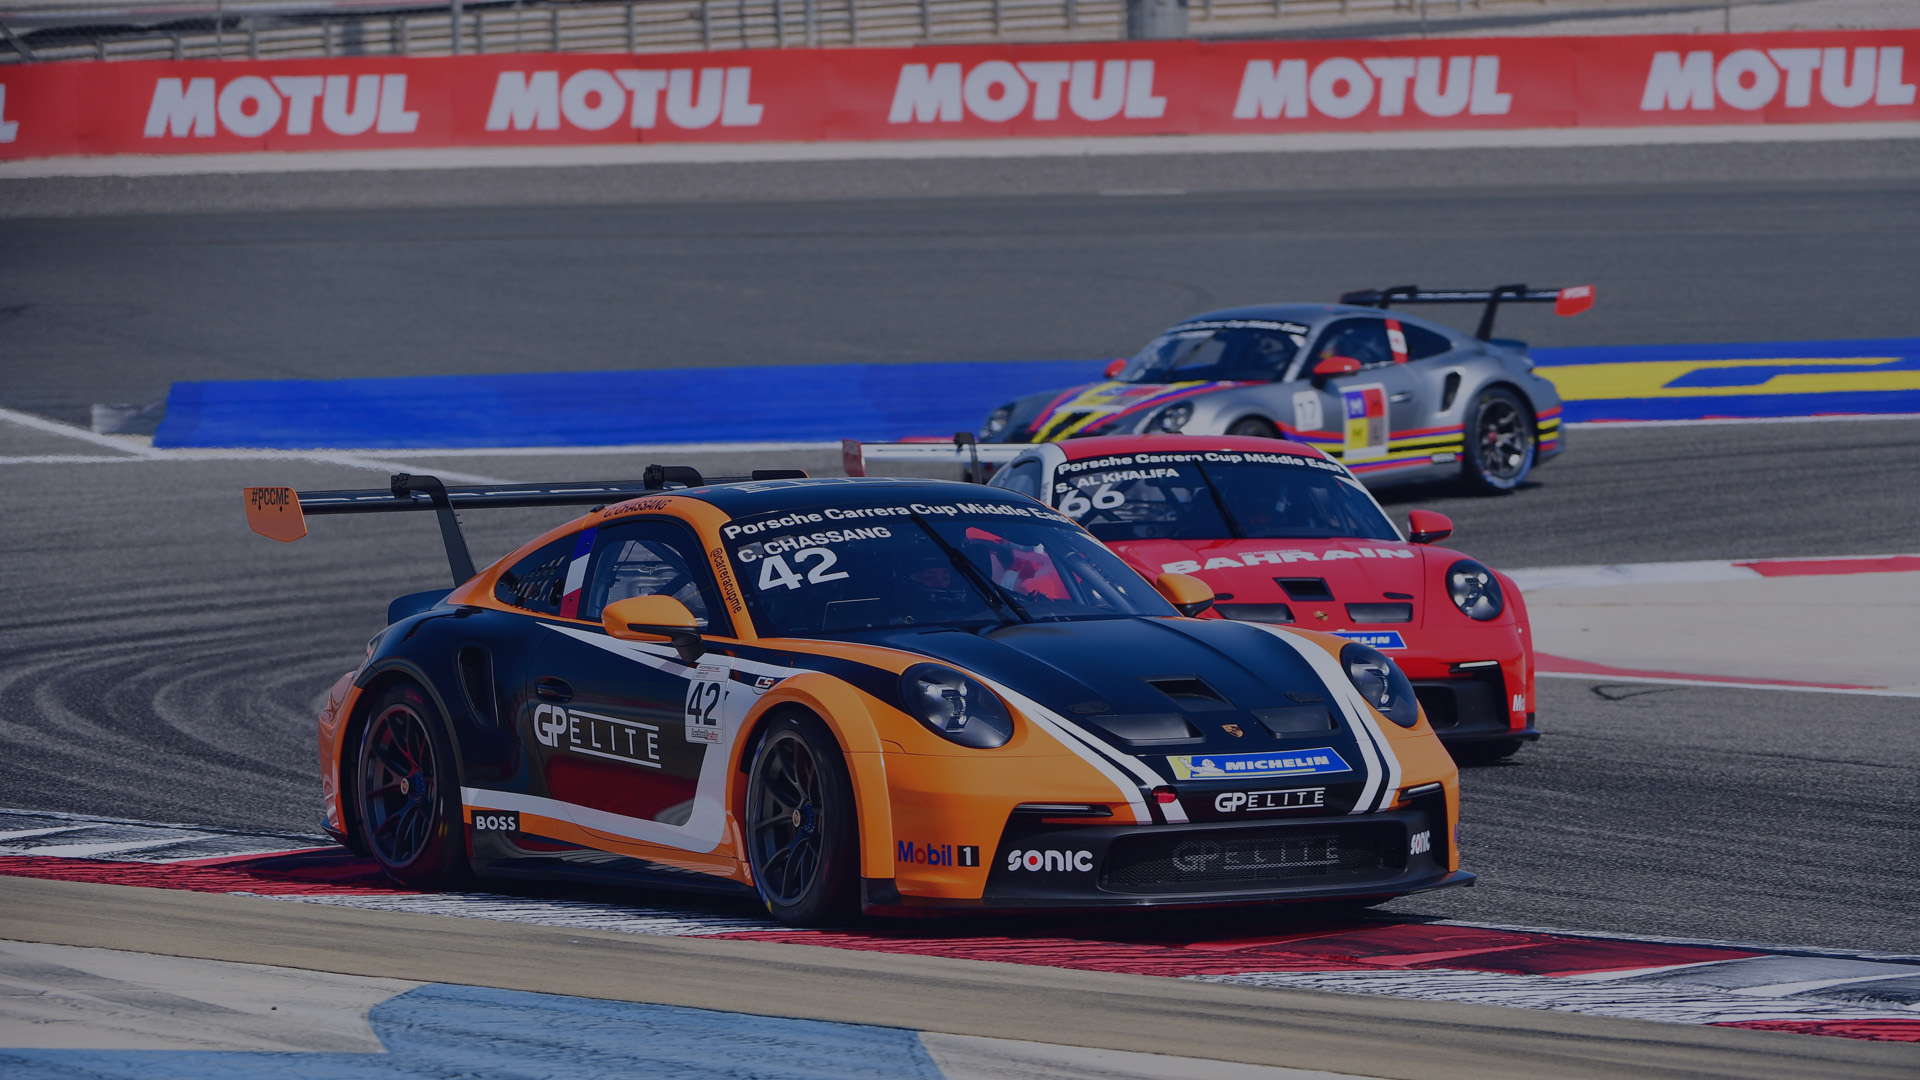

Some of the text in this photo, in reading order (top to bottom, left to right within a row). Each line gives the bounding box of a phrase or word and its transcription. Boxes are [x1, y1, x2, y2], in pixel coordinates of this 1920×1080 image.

[888, 59, 1168, 125] MOTUL
[1232, 55, 1513, 120] MOTUL
[1640, 47, 1917, 111] MOTUL
[144, 73, 420, 138] MOTUL
[486, 66, 765, 132] MOTUL
[1055, 468, 1180, 493] S. AL KHALIFA
[1058, 452, 1345, 475] Porsche Carrera Cup Middle East
[251, 488, 290, 506] #PCCME
[1058, 484, 1126, 518] 66
[723, 502, 1076, 540] Porsche Carrera Cup Middle East
[763, 526, 892, 556] CHASSANG
[757, 547, 850, 591] 42
[1160, 547, 1415, 574] BAHRAIN
[710, 547, 742, 614] @carreracupme
[687, 681, 721, 726] 42
[1225, 755, 1330, 772] MICHELIN
[475, 815, 516, 831] BOSS
[898, 840, 974, 867] Mobil 1
